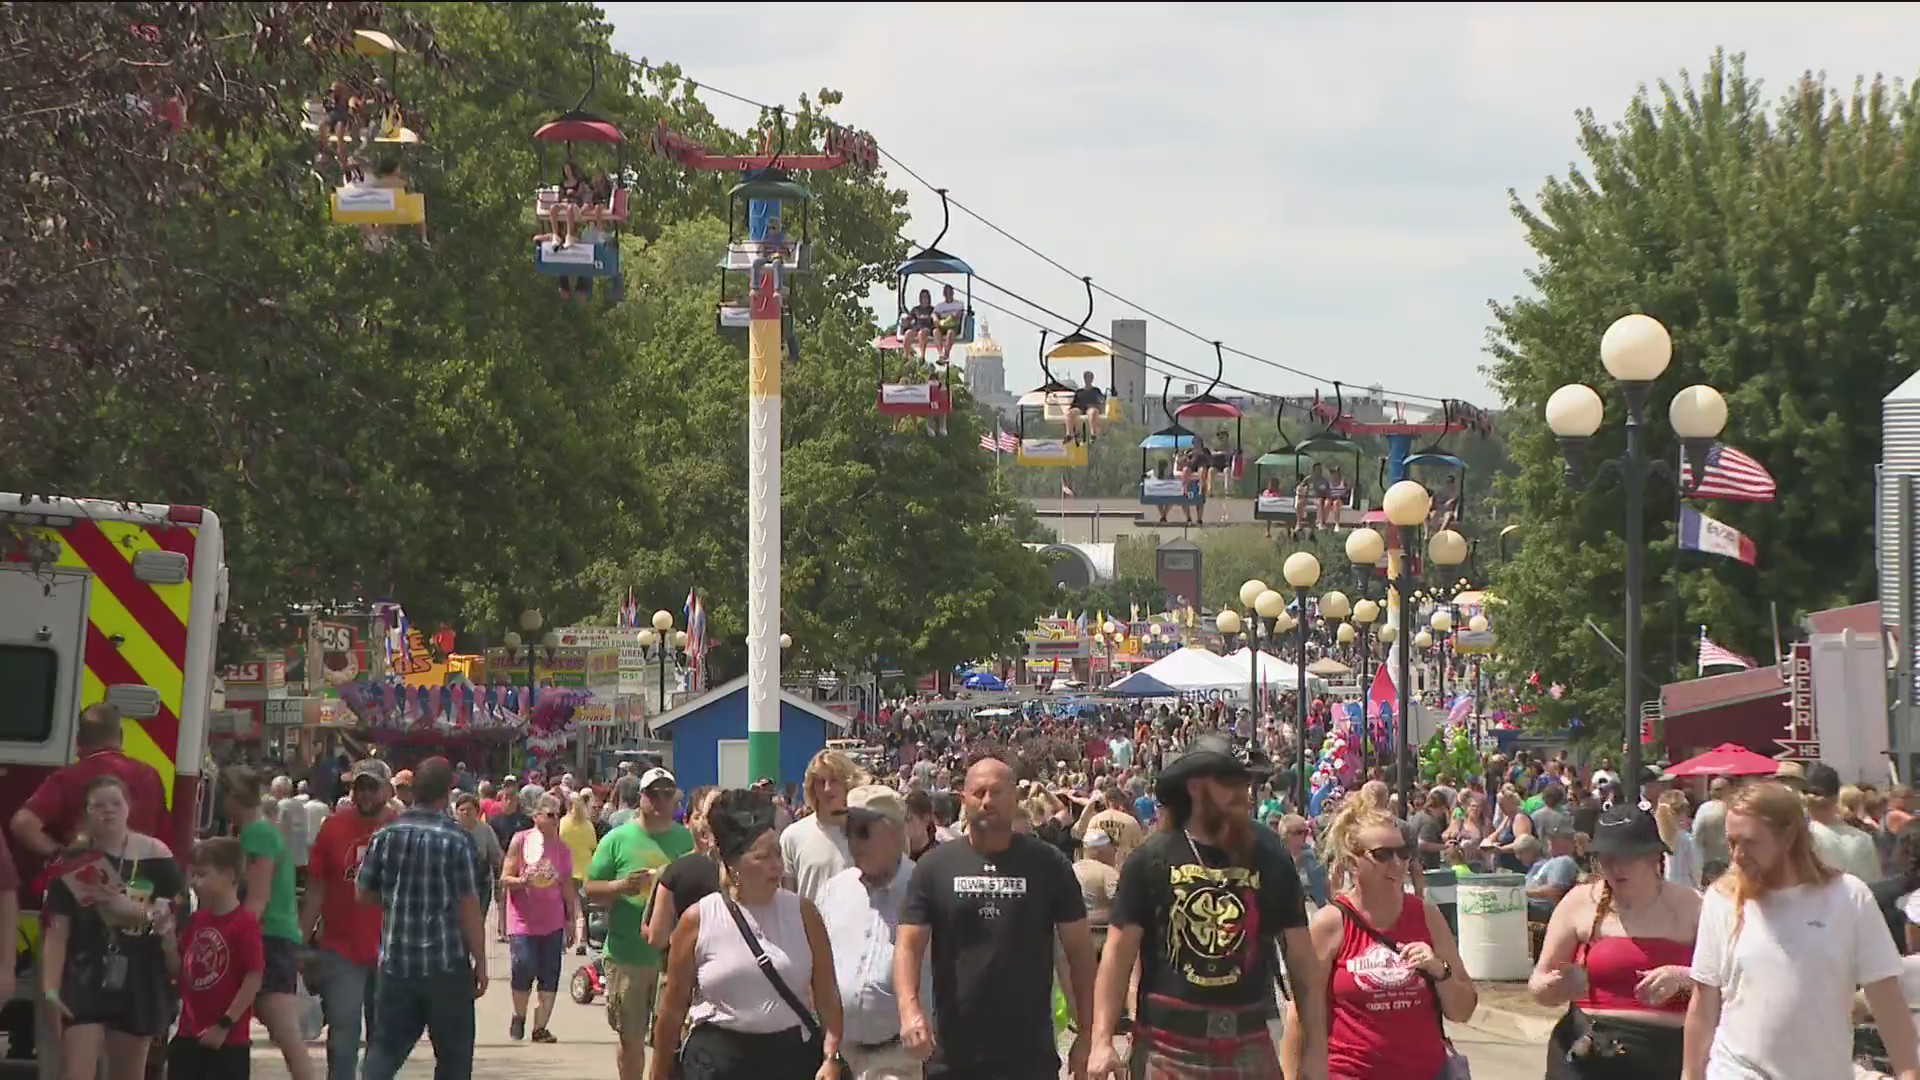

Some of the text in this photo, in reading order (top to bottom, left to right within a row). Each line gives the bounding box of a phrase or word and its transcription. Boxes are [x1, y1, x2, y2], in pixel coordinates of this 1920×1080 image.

[590, 640, 641, 649] PICKLEDAWG
[1796, 658, 1810, 726] BEER
[957, 879, 1024, 891] IOWA STATE
